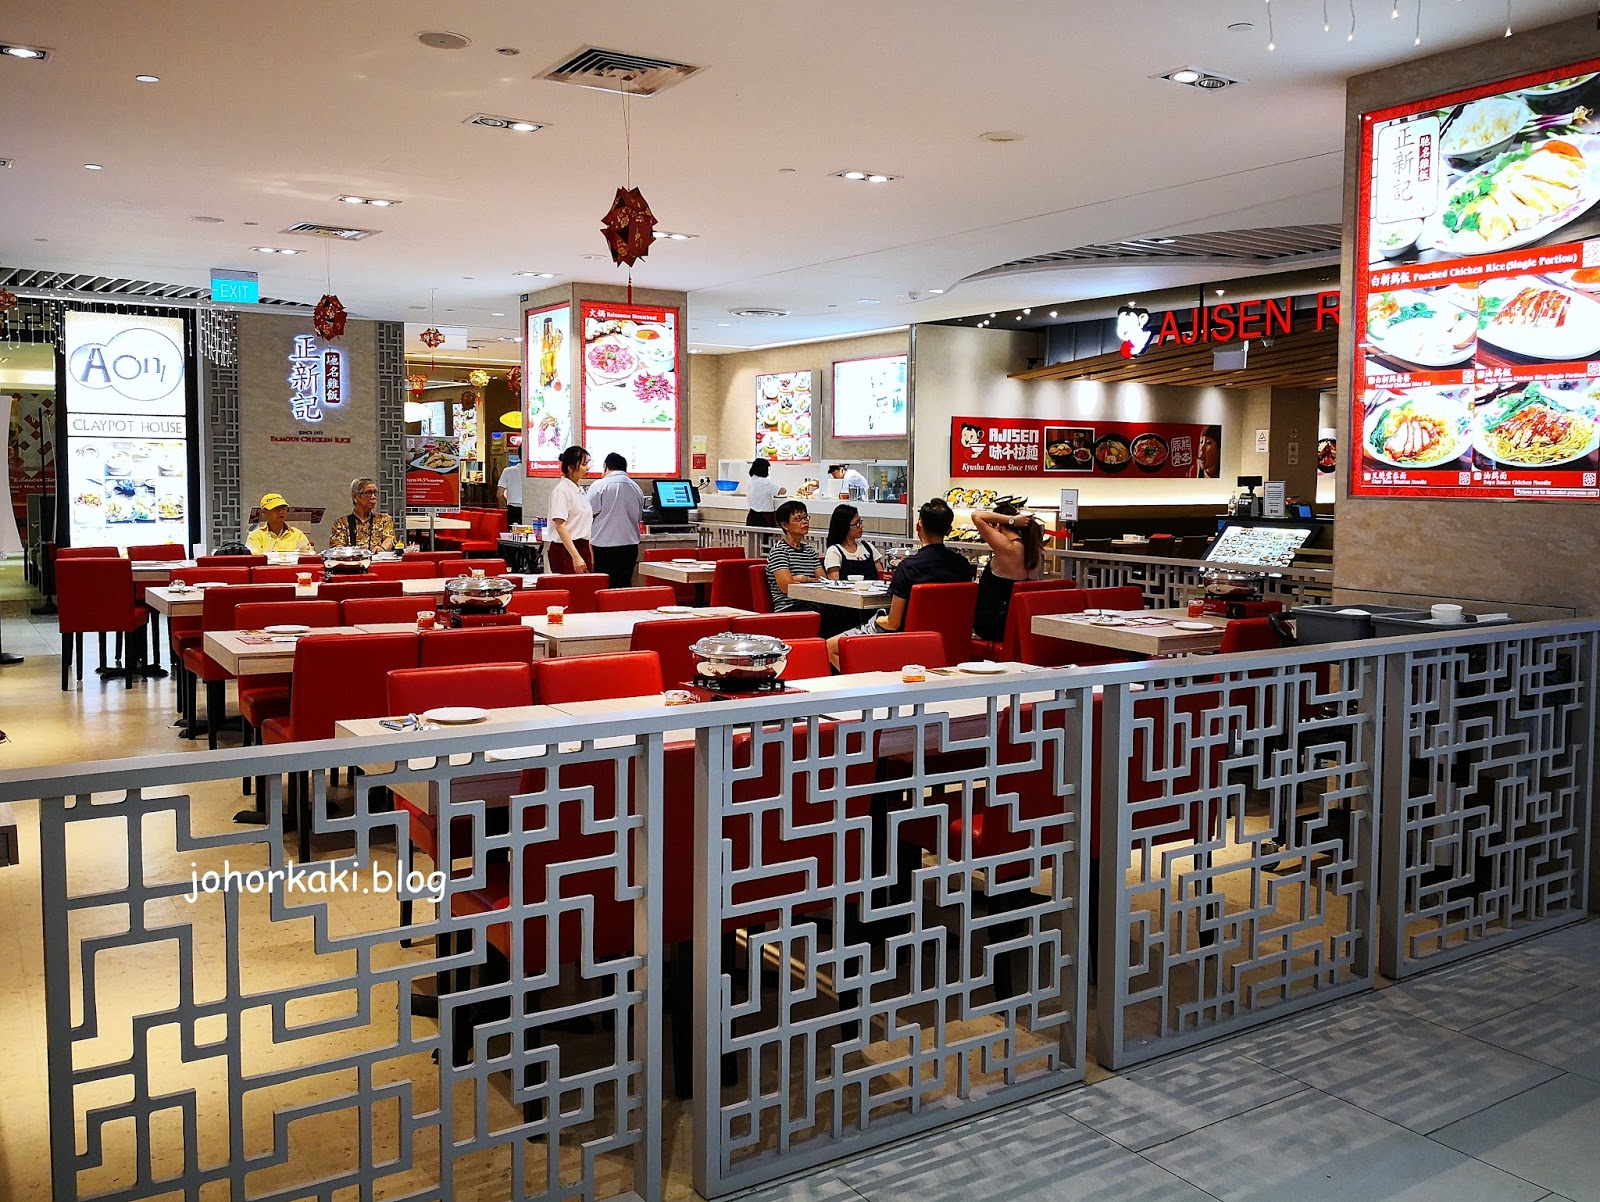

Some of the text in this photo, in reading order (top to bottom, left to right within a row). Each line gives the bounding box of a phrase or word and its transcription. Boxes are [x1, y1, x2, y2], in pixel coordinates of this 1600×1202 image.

[1393, 126, 1415, 201] 正新記
[1449, 265, 1484, 276] Chicken
[220, 283, 249, 299] EXIT
[1157, 295, 1293, 347] AJISEN
[290, 336, 323, 420] 正新記
[73, 419, 182, 433] CLAYPOT HOUSE
[989, 428, 1039, 443] AJISEN
[962, 462, 985, 472] Kyushu
[985, 463, 1006, 471] Ramen
